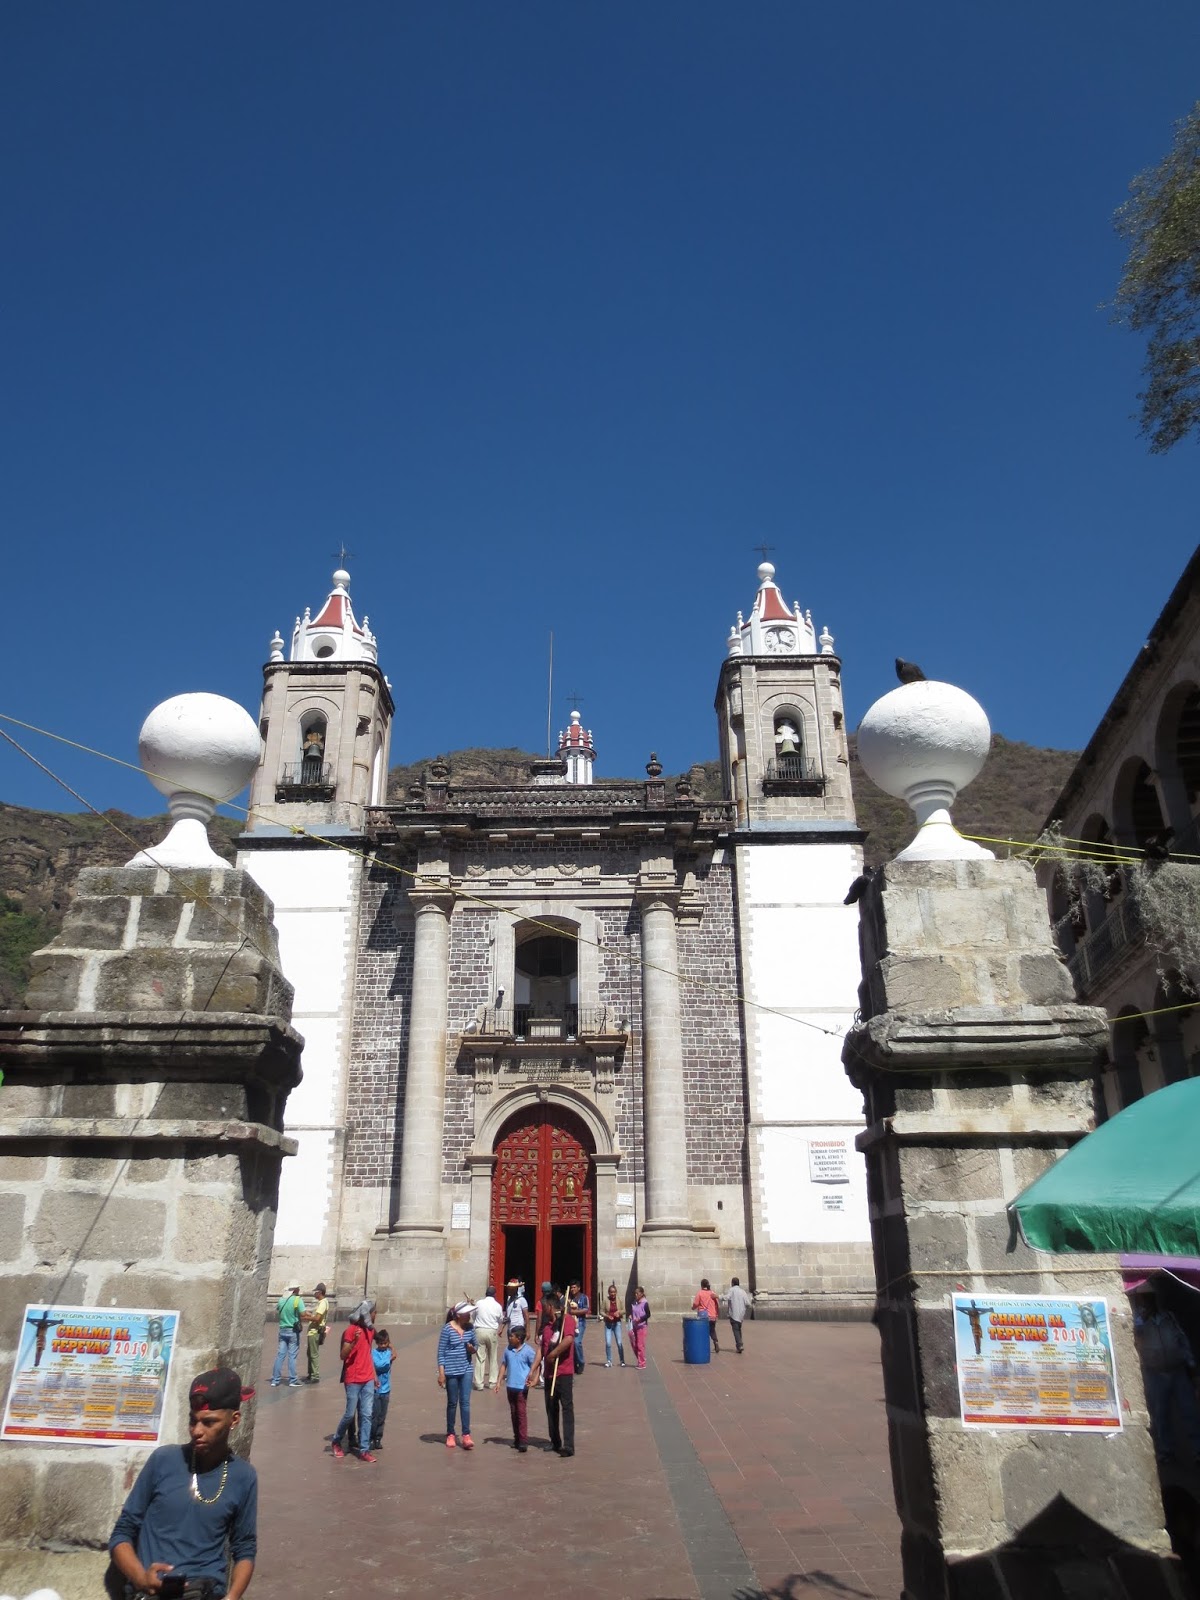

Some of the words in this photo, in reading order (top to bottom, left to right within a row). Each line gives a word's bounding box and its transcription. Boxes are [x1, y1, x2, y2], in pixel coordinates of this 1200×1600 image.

[989, 1312, 1047, 1327] CHALMA
[1048, 1313, 1066, 1328] AL
[56, 1324, 112, 1340] CHALMA
[113, 1327, 131, 1341] AL
[987, 1327, 1049, 1342] TEPEYAC
[1052, 1327, 1086, 1344] 2019
[51, 1339, 111, 1354] TEPEYAC
[114, 1341, 148, 1357] 2019
